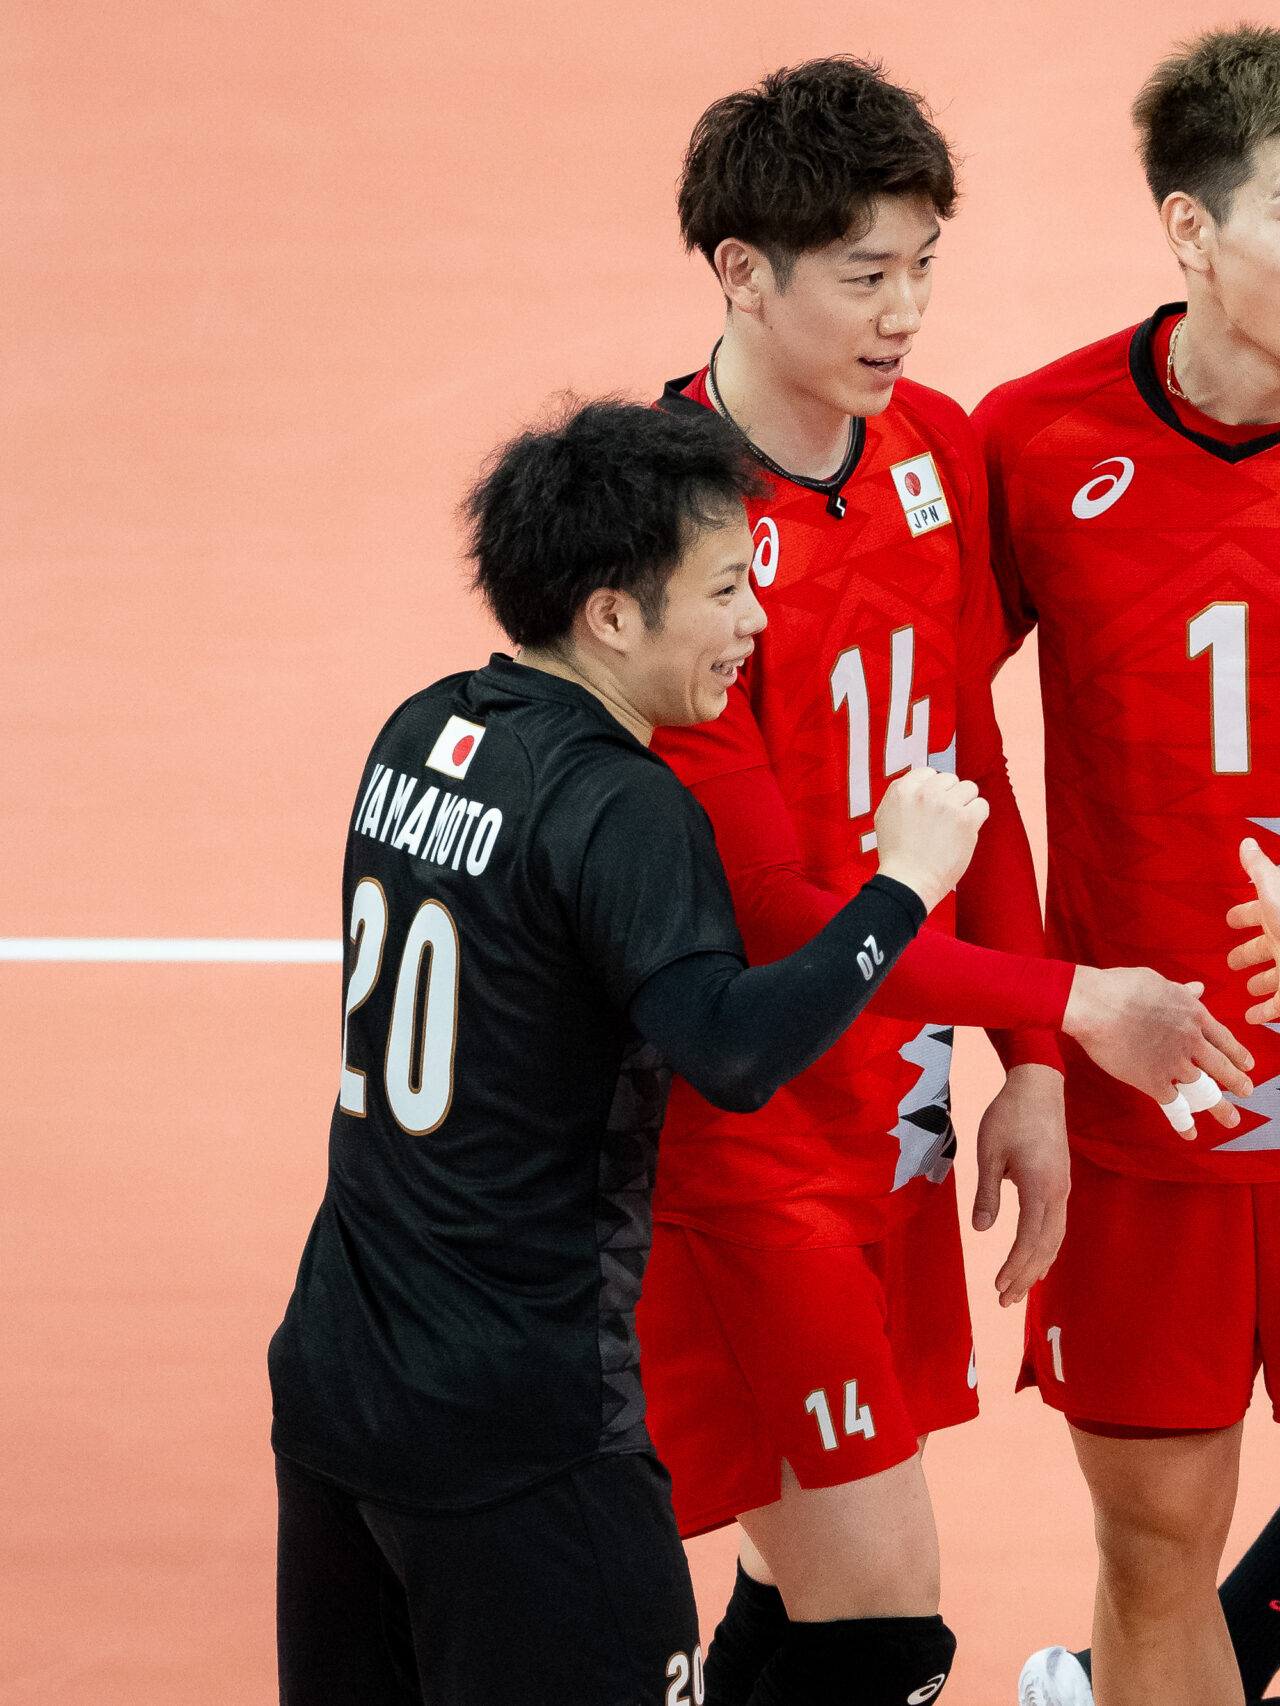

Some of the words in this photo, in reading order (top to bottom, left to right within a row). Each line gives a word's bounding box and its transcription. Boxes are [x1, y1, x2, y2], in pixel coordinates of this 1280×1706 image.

[913, 505, 940, 528] JPN
[829, 624, 930, 819] 14
[1186, 601, 1251, 775] 1
[355, 763, 502, 877] YAMAMOTO
[340, 876, 460, 1137] 20
[1046, 1325, 1066, 1384] 1
[804, 1379, 876, 1452] 14
[665, 1643, 705, 1706] 20
